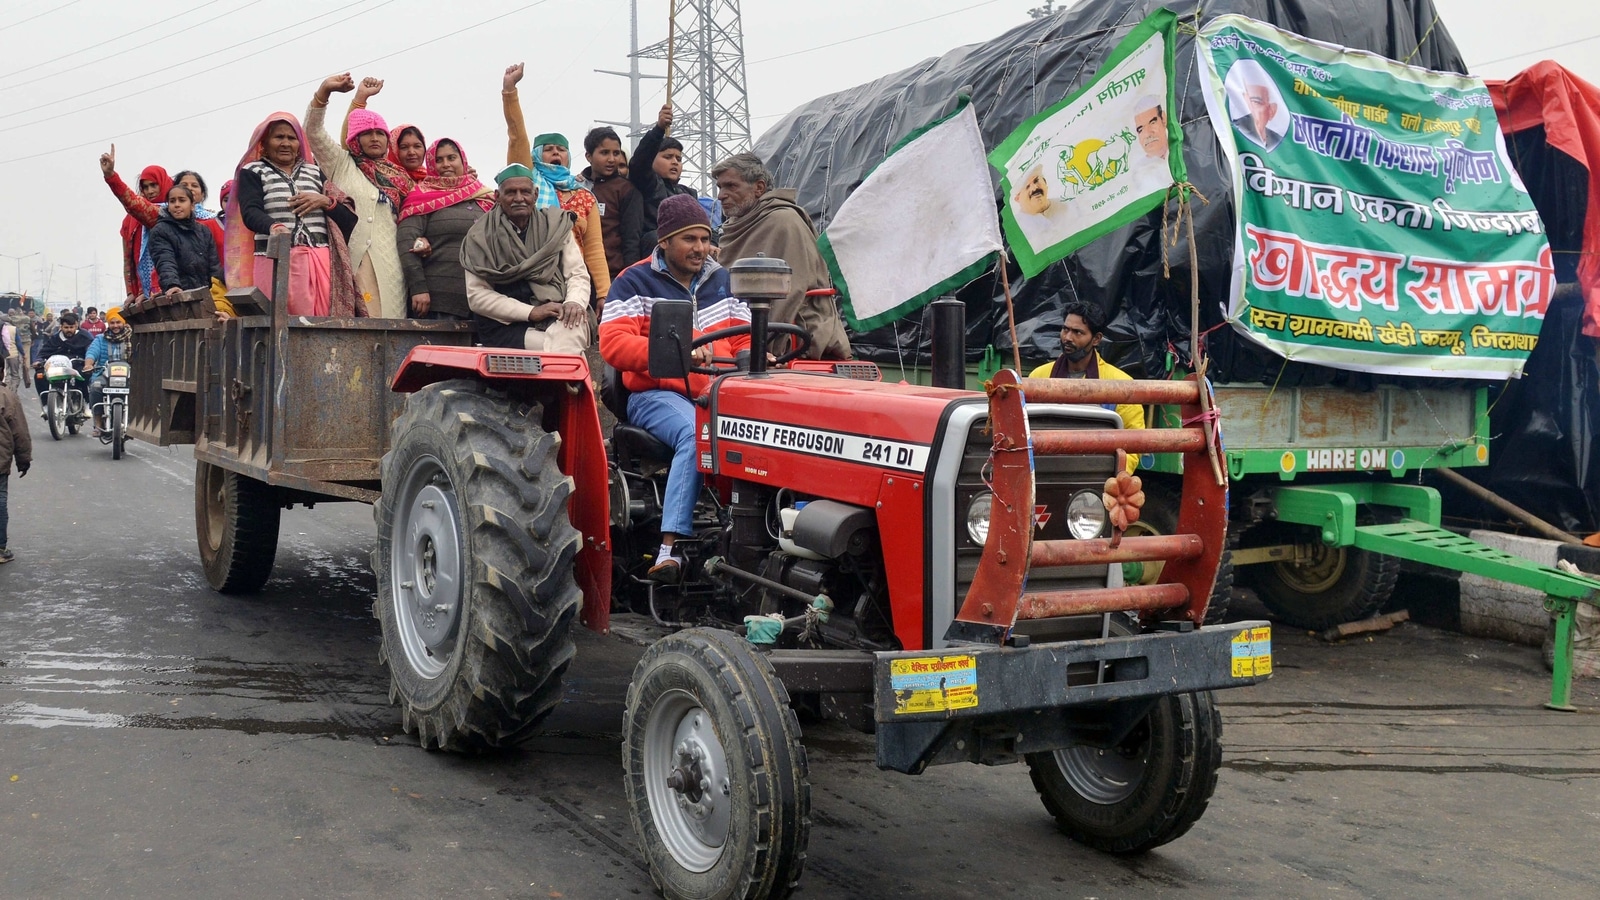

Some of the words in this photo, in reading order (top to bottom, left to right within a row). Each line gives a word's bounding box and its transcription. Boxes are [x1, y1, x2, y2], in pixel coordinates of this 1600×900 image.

[1238, 152, 1343, 214] किसान
[1347, 189, 1433, 230] एकता
[1432, 198, 1545, 236] जिन्दाब
[1289, 313, 1374, 342] ग्रामवासी
[720, 419, 769, 443] MASSEY
[773, 427, 845, 455] FERGUSON
[862, 442, 891, 462] 241
[896, 447, 914, 466] DI
[1307, 449, 1355, 471] HARE
[1360, 449, 1388, 470] OM
